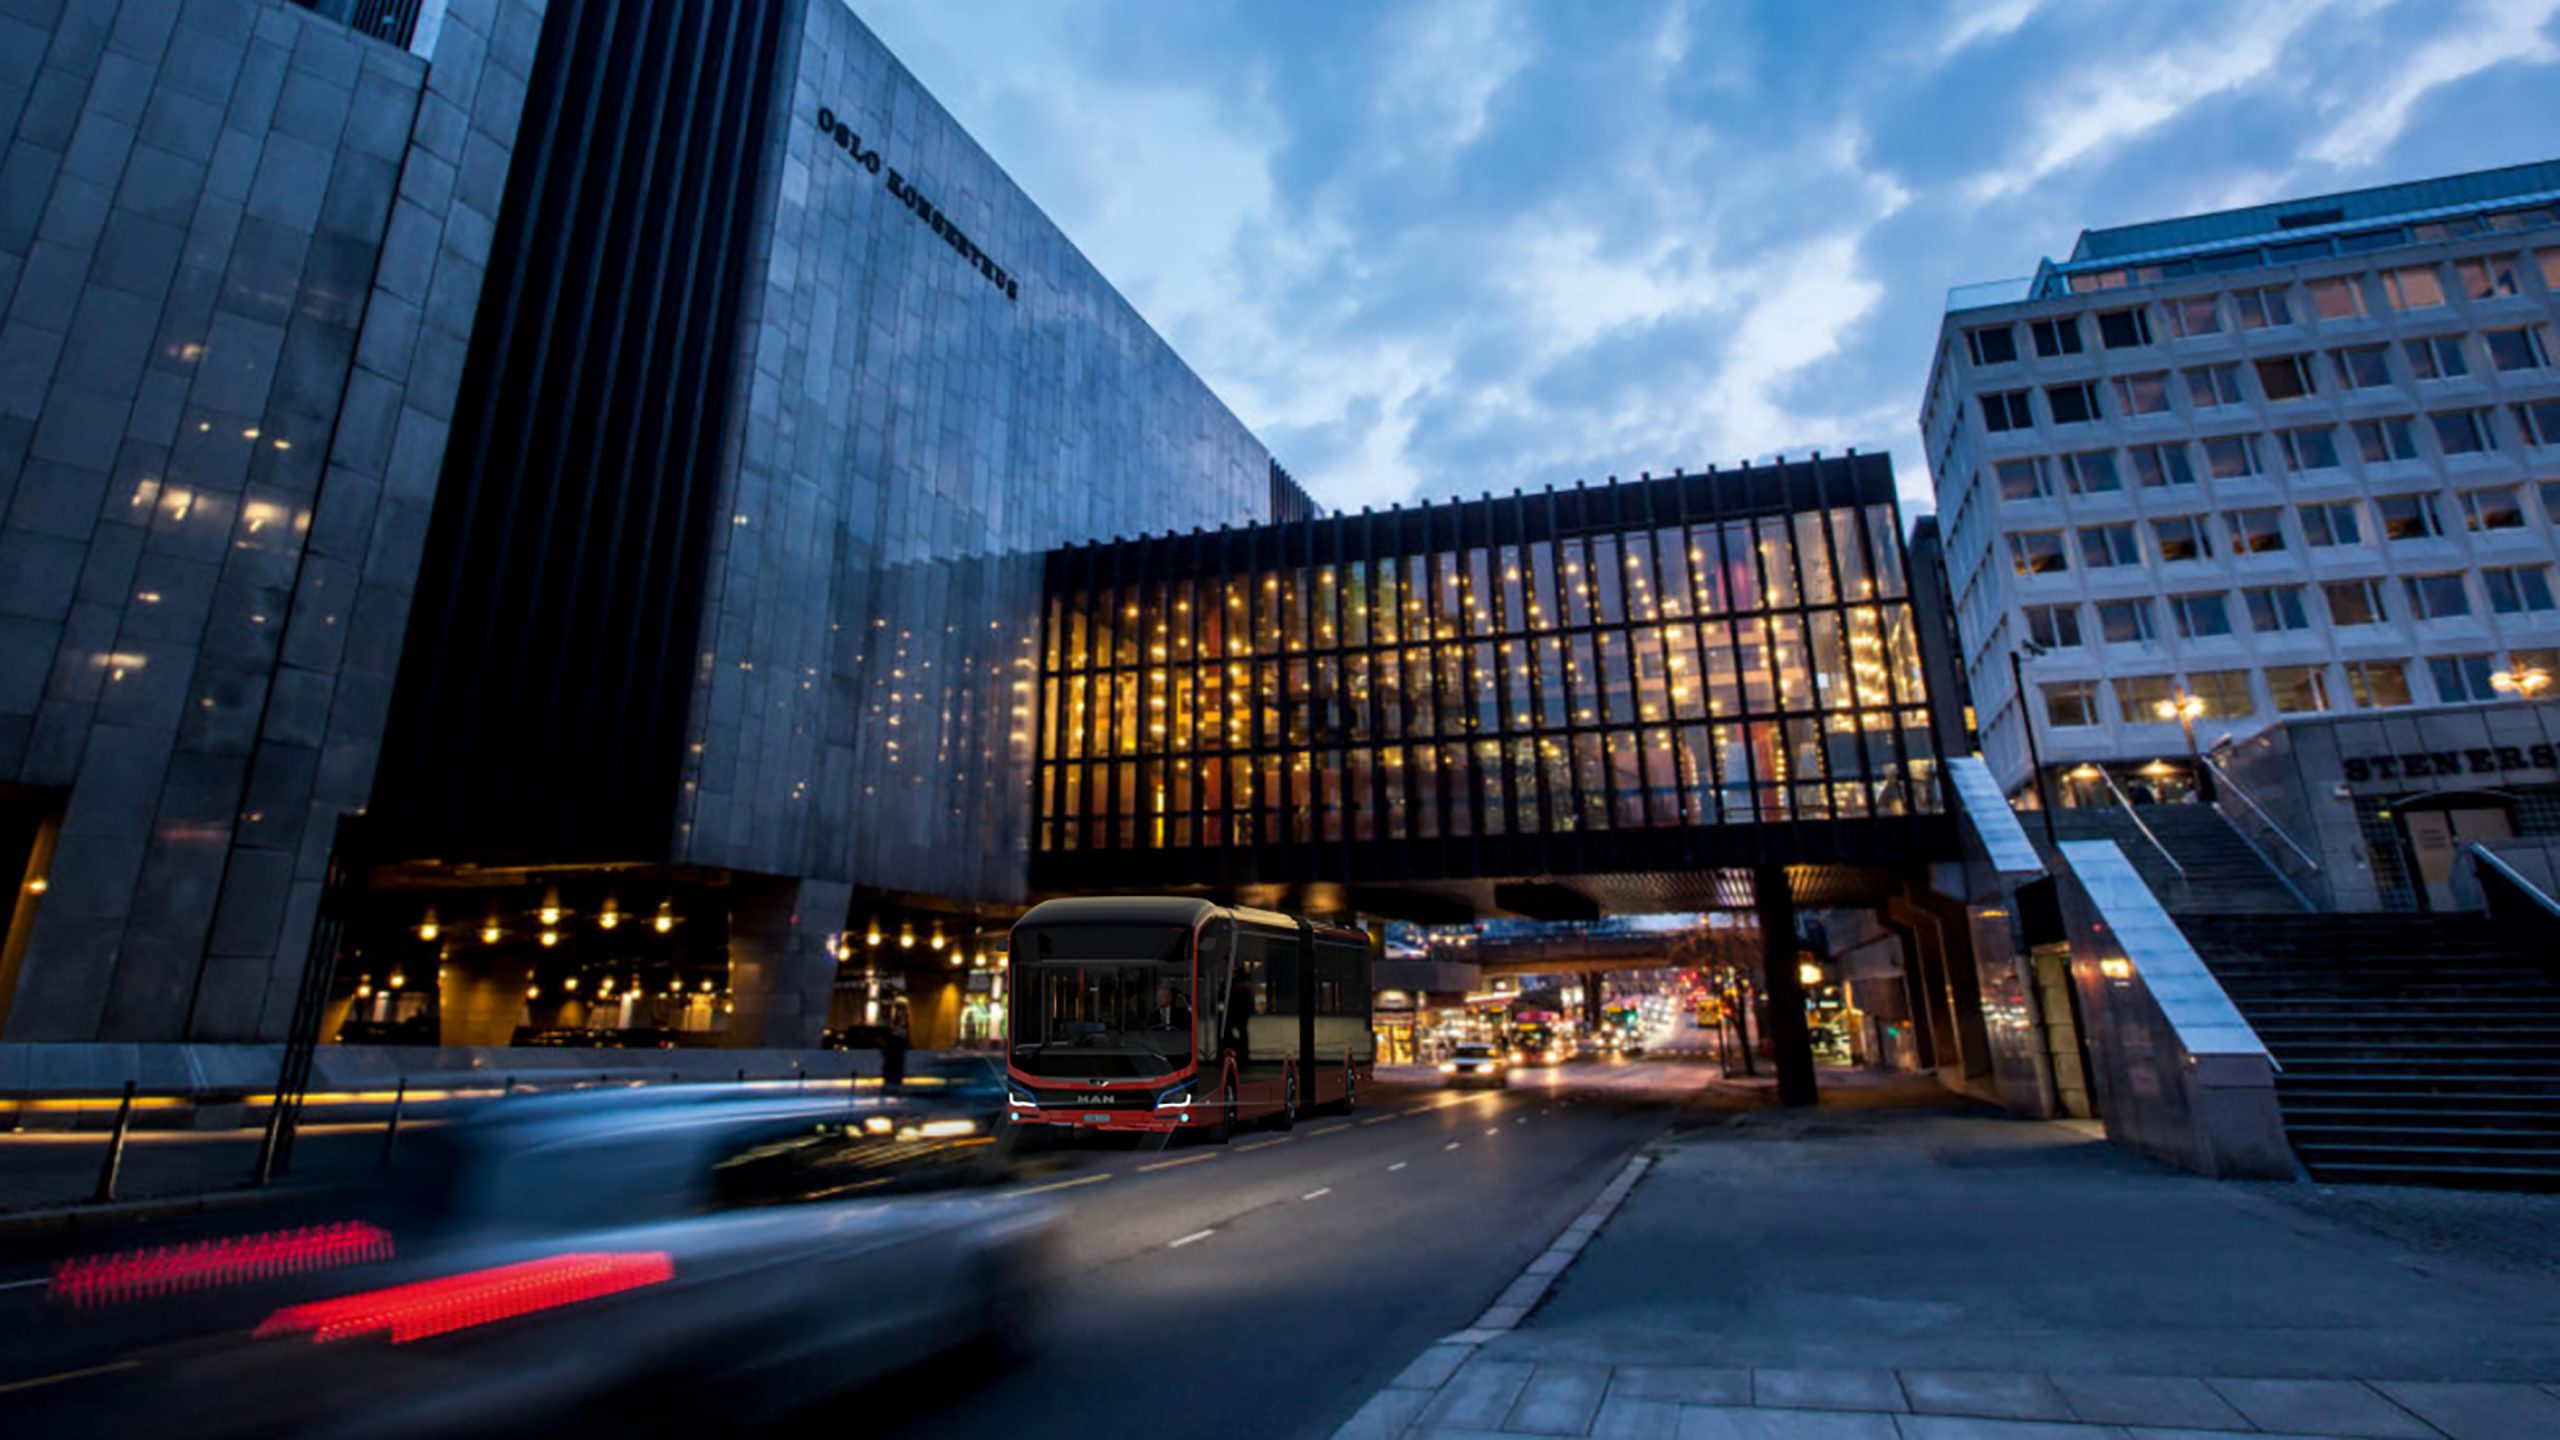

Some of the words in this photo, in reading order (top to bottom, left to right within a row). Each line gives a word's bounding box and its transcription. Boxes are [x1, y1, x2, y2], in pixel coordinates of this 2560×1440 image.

[818, 107, 880, 174] OSLO
[887, 167, 1018, 300] KONSERTHUS
[2345, 741, 2560, 782] STENERS
[1077, 1095, 1114, 1104] MAN
